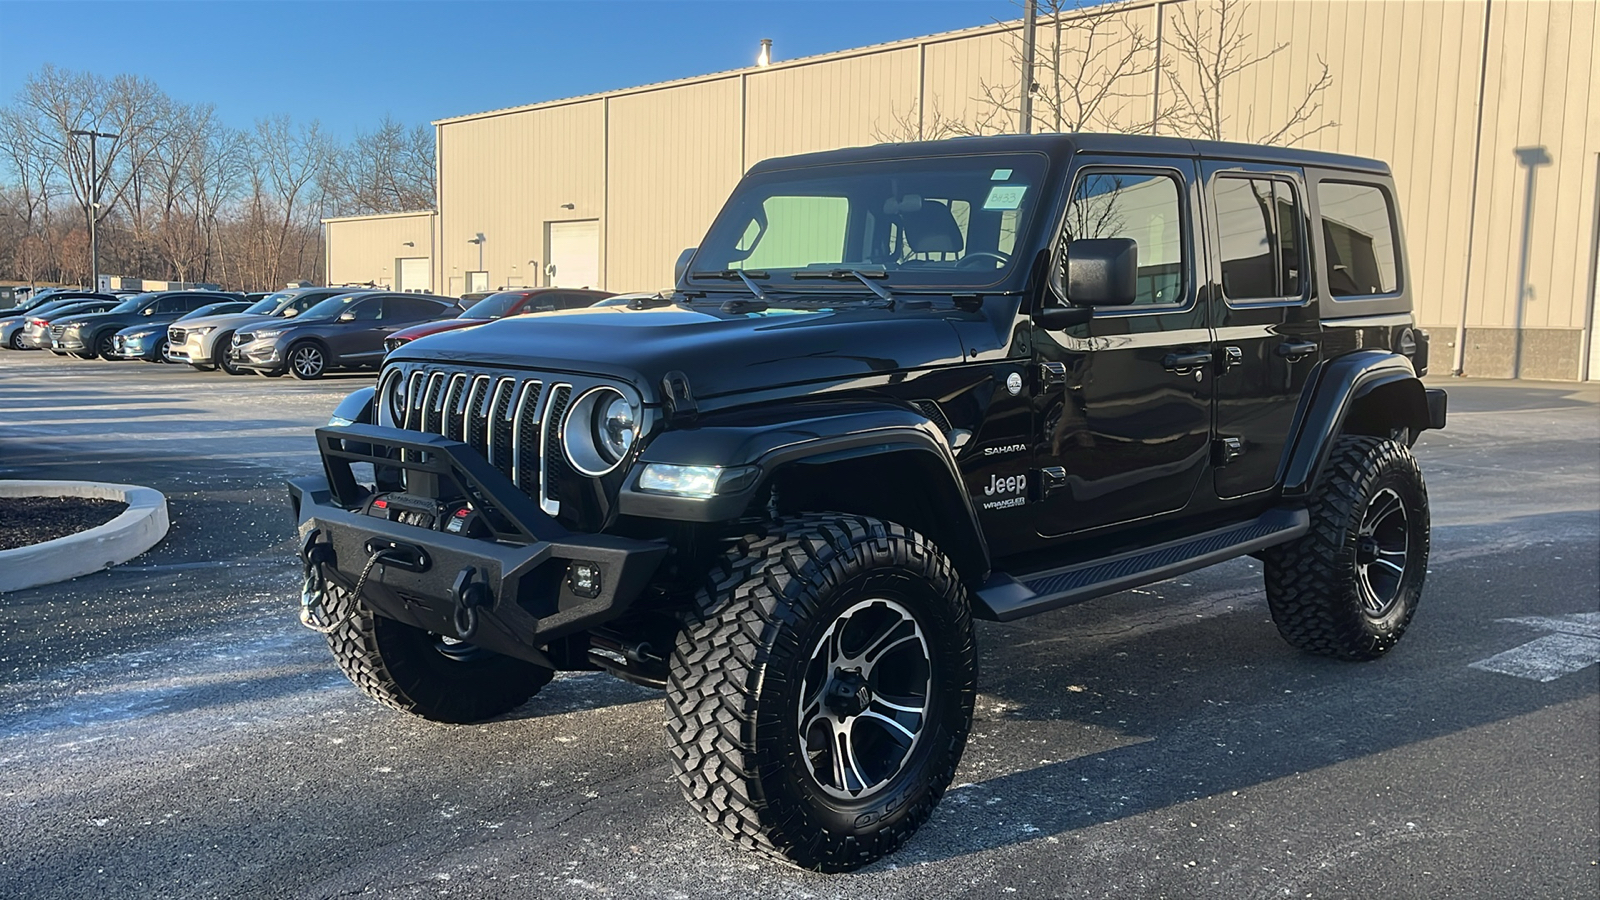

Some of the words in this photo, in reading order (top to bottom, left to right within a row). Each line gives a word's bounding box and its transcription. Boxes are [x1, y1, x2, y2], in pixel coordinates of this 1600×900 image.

[984, 443, 1027, 456] SAHARA
[984, 474, 1027, 496] Jeep
[983, 496, 1026, 509] WRANGLER
